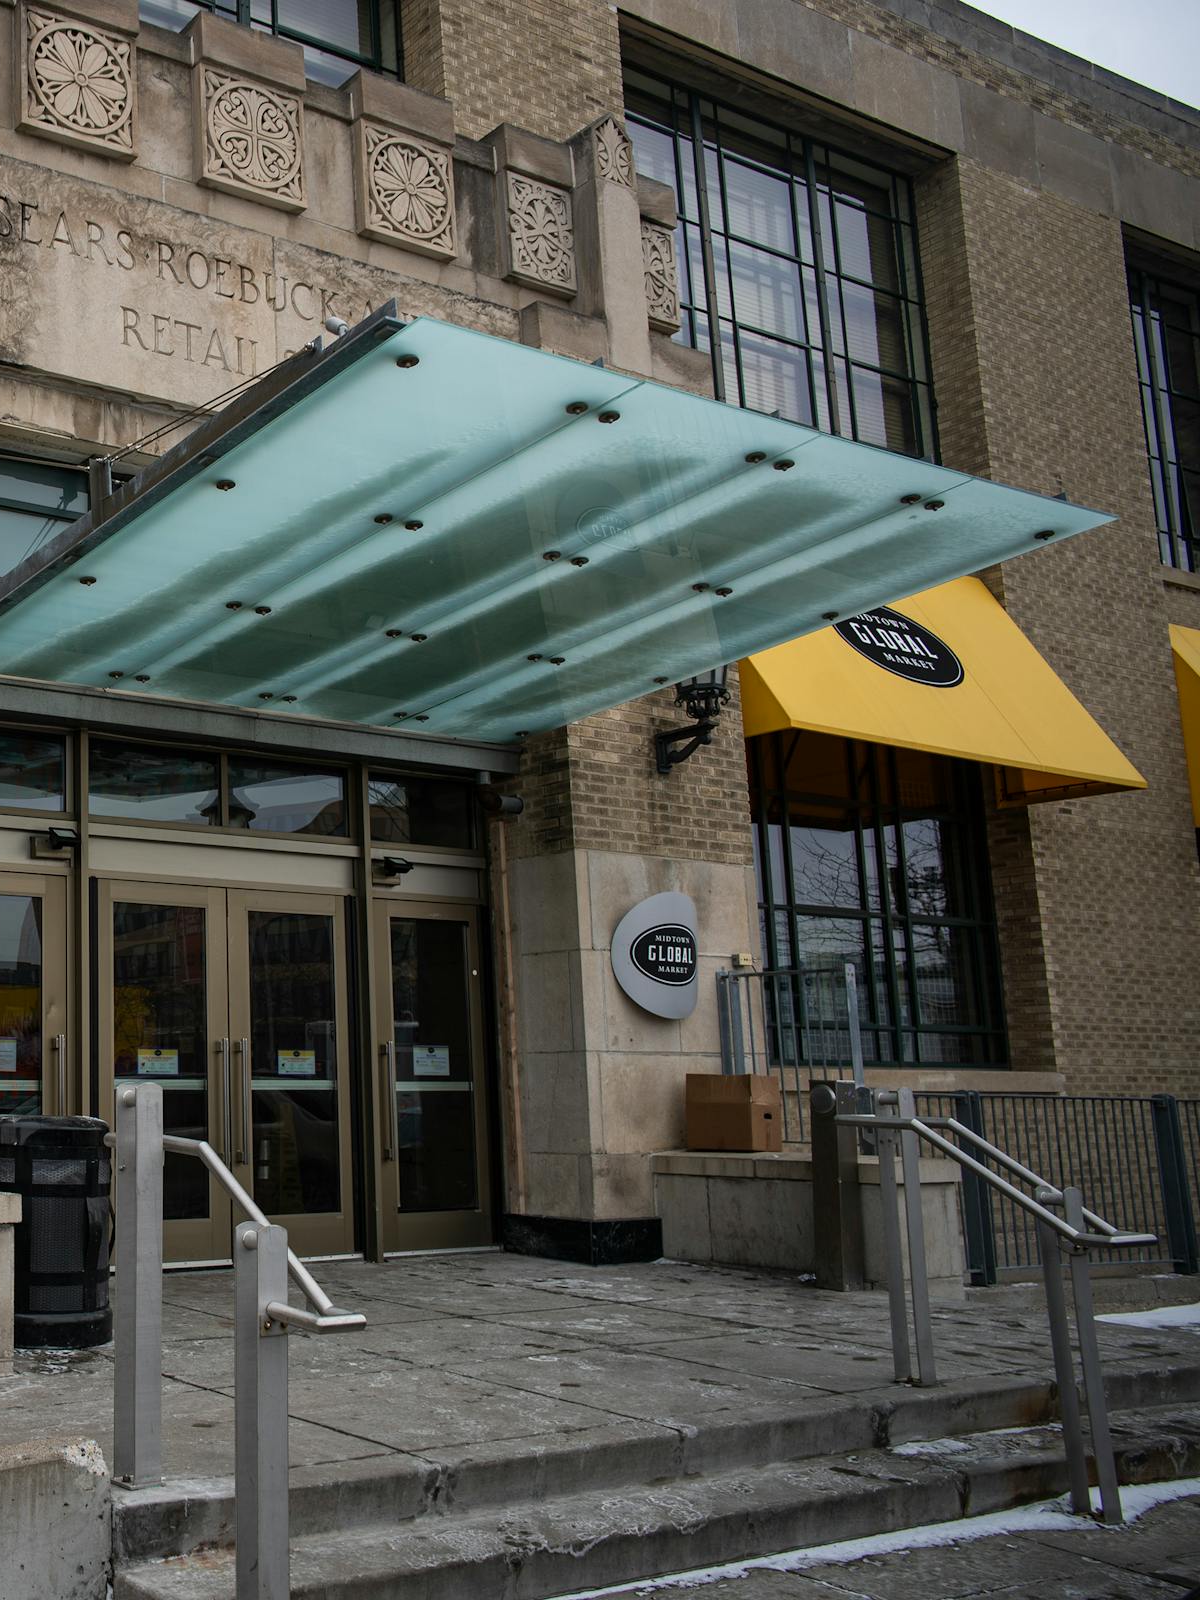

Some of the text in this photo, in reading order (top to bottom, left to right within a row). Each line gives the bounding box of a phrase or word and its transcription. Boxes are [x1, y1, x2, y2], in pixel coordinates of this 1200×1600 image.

[855, 612, 909, 630] IDTOWN
[849, 621, 939, 659] GLOBAL
[883, 652, 936, 671] MARKET
[655, 934, 690, 944] MIDTOWN
[647, 944, 693, 964] GLOBAL
[658, 965, 688, 974] MARKET
